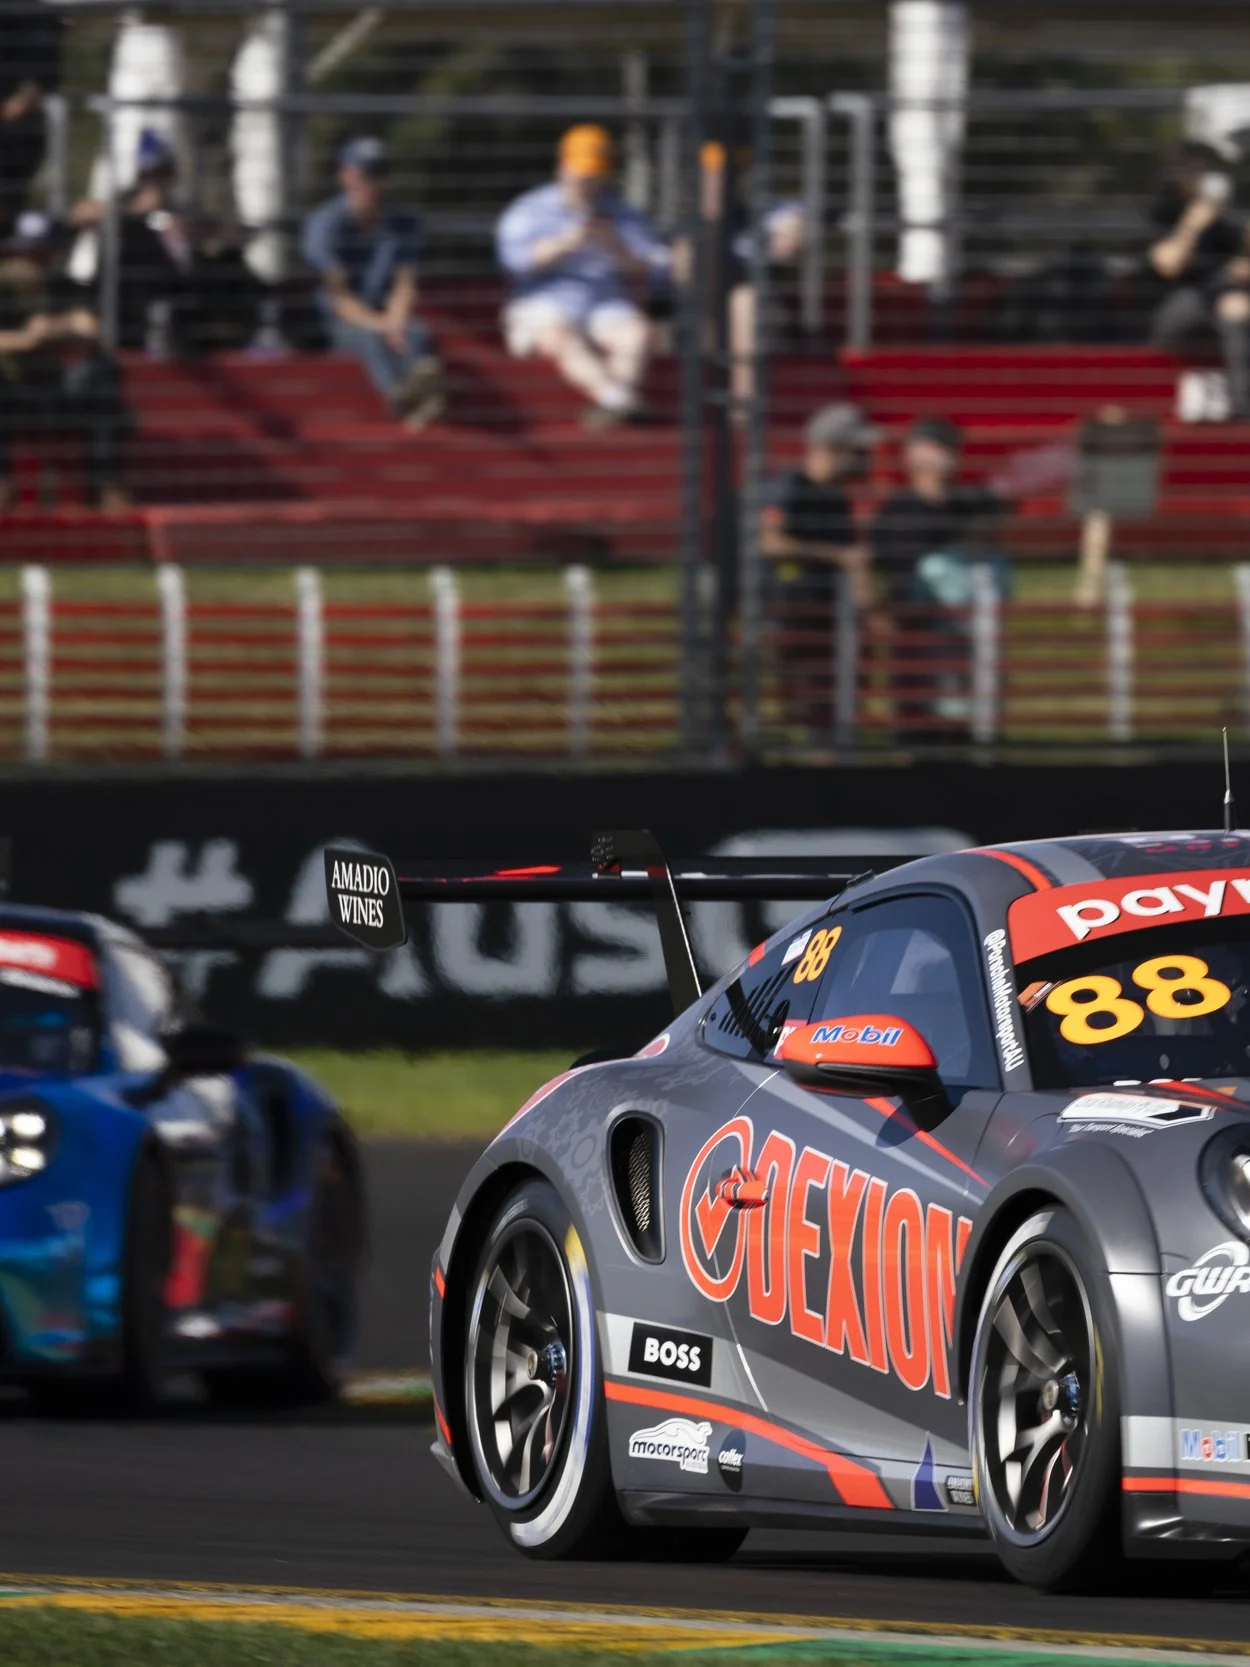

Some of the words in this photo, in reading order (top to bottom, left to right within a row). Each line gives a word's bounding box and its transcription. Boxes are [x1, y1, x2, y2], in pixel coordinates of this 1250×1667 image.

[331, 860, 390, 896] AMADIO
[337, 894, 384, 929] WINES
[793, 925, 843, 985] 88
[1045, 954, 1232, 1046] 88
[809, 1024, 905, 1048] Mobil
[746, 1128, 974, 1399] DEXION
[643, 1336, 702, 1373] BOSS
[631, 1440, 708, 1466] motorsport
